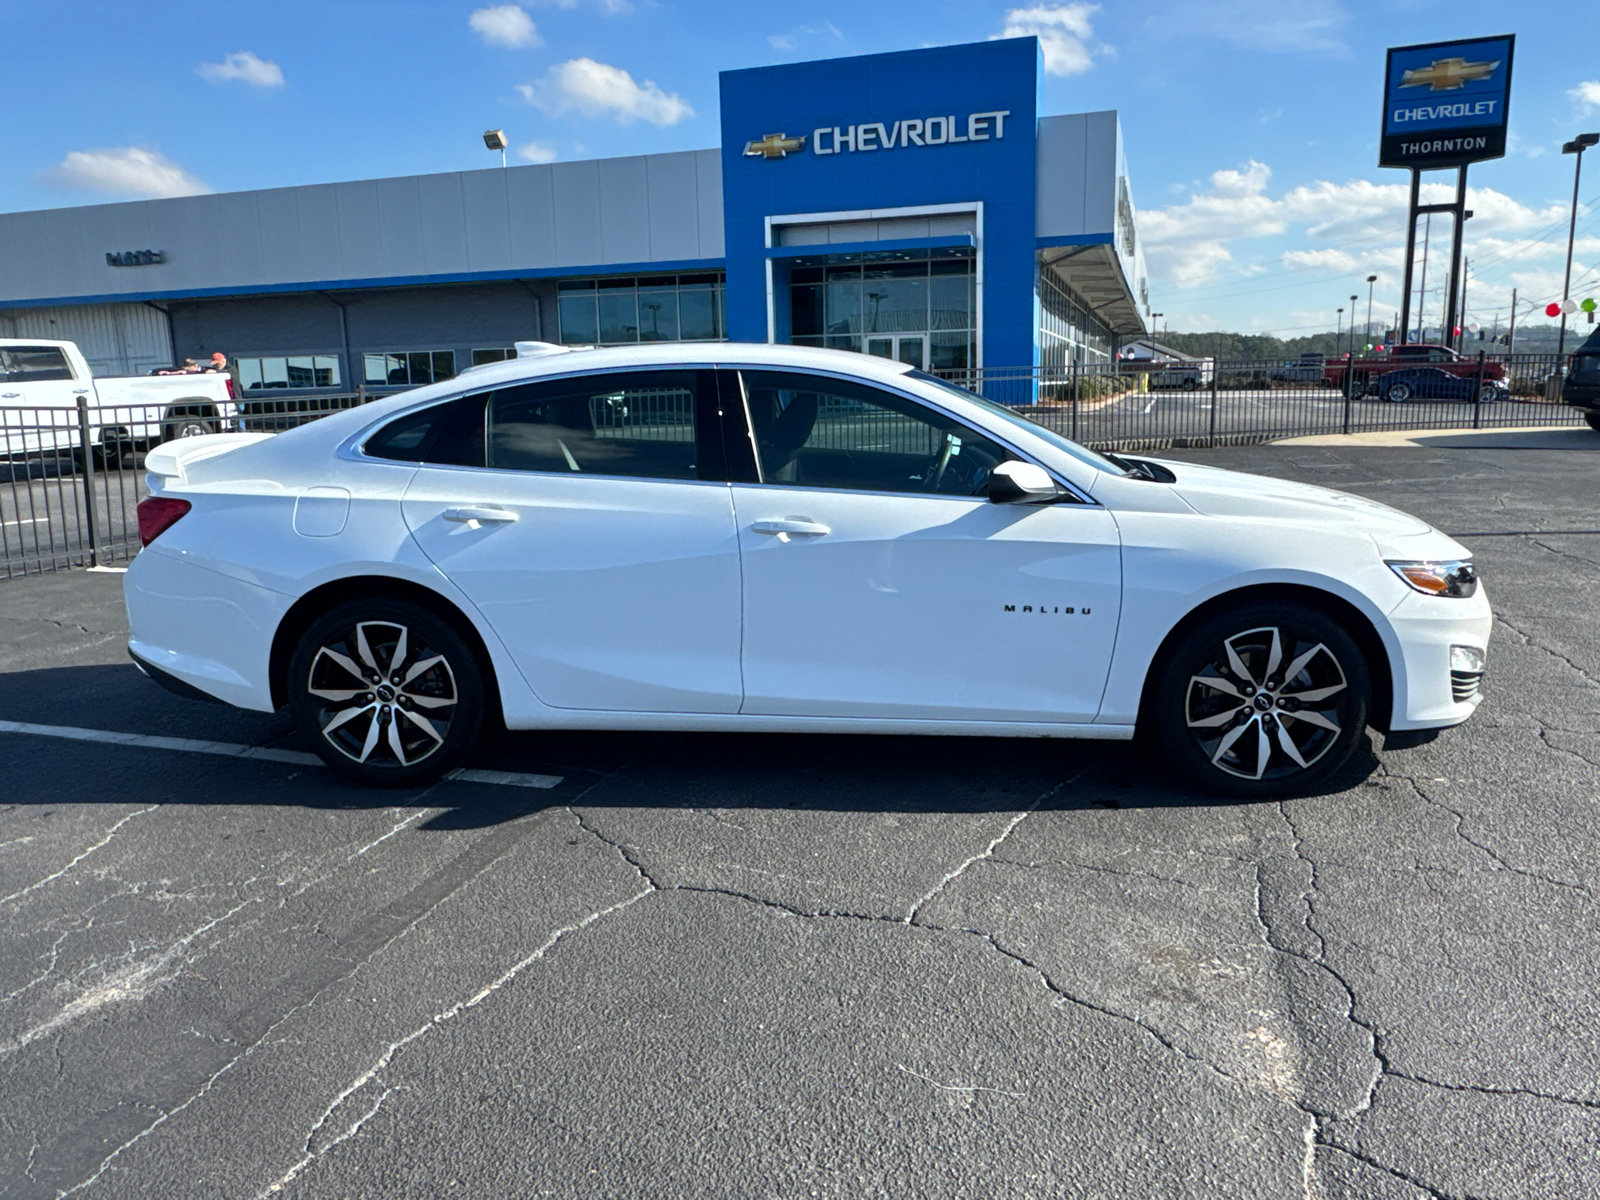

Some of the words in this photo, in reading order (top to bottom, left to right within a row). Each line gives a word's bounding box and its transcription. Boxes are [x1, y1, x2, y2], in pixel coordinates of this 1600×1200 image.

[1393, 100, 1498, 123] CHEVROLET
[813, 110, 1010, 155] CHEVROLET
[1400, 137, 1487, 155] THORNTON
[1004, 604, 1092, 615] MALIBU
